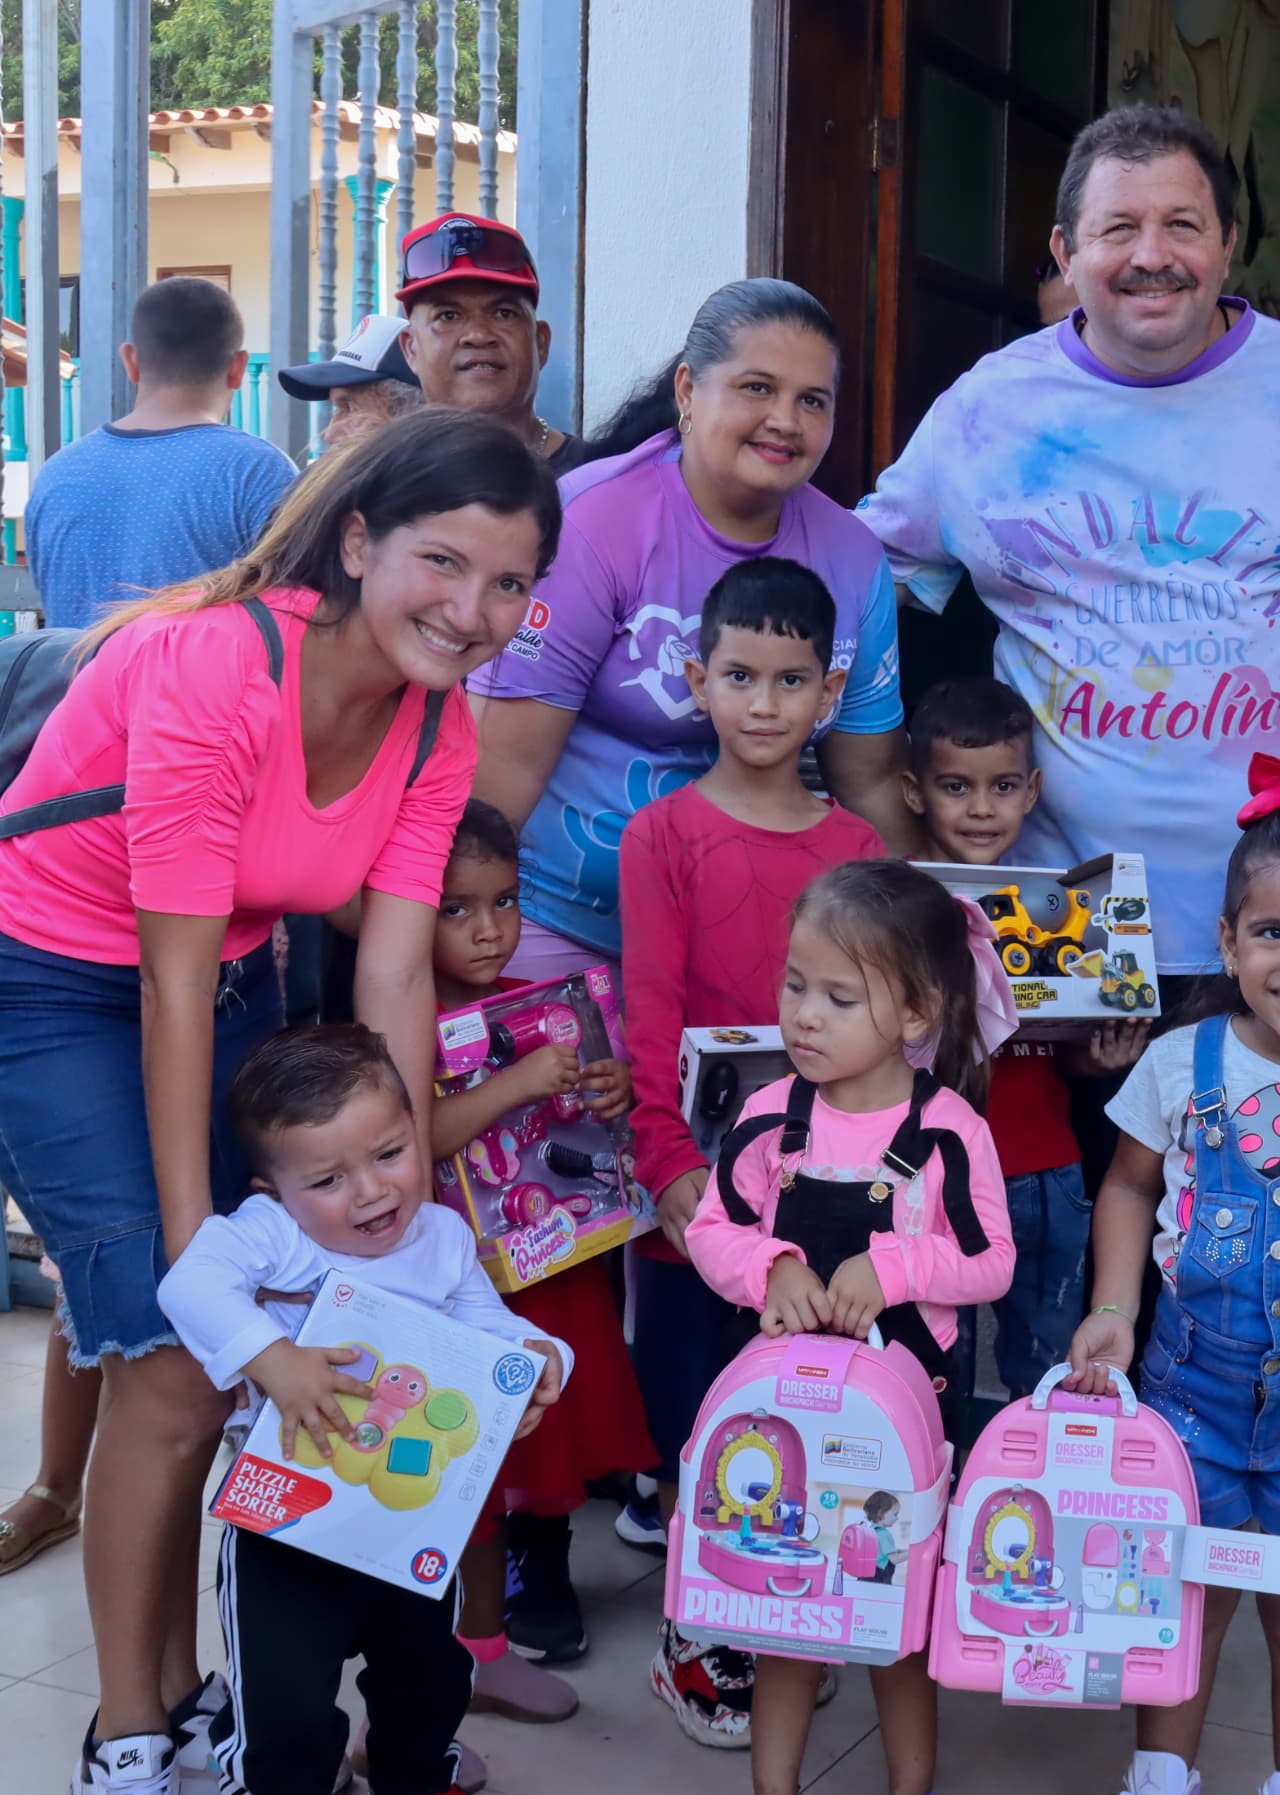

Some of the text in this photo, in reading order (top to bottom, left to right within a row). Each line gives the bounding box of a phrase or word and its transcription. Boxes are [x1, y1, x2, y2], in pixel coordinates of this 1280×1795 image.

[1066, 581, 1238, 624] GUERREROS
[1136, 635, 1250, 668] AMOR
[1059, 671, 1274, 741] Antolín
[781, 1380, 838, 1401] DRESSER
[1056, 1442, 1104, 1458] DRESSER
[232, 1475, 285, 1505] SHAPE
[239, 1461, 298, 1494] PUZZLE
[225, 1488, 288, 1521] SORTER
[1057, 1489, 1168, 1521] PRINCESS
[1209, 1545, 1260, 1566] DRESSER
[684, 1587, 843, 1640] PRINCESS
[120, 1749, 138, 1762] NIKE
